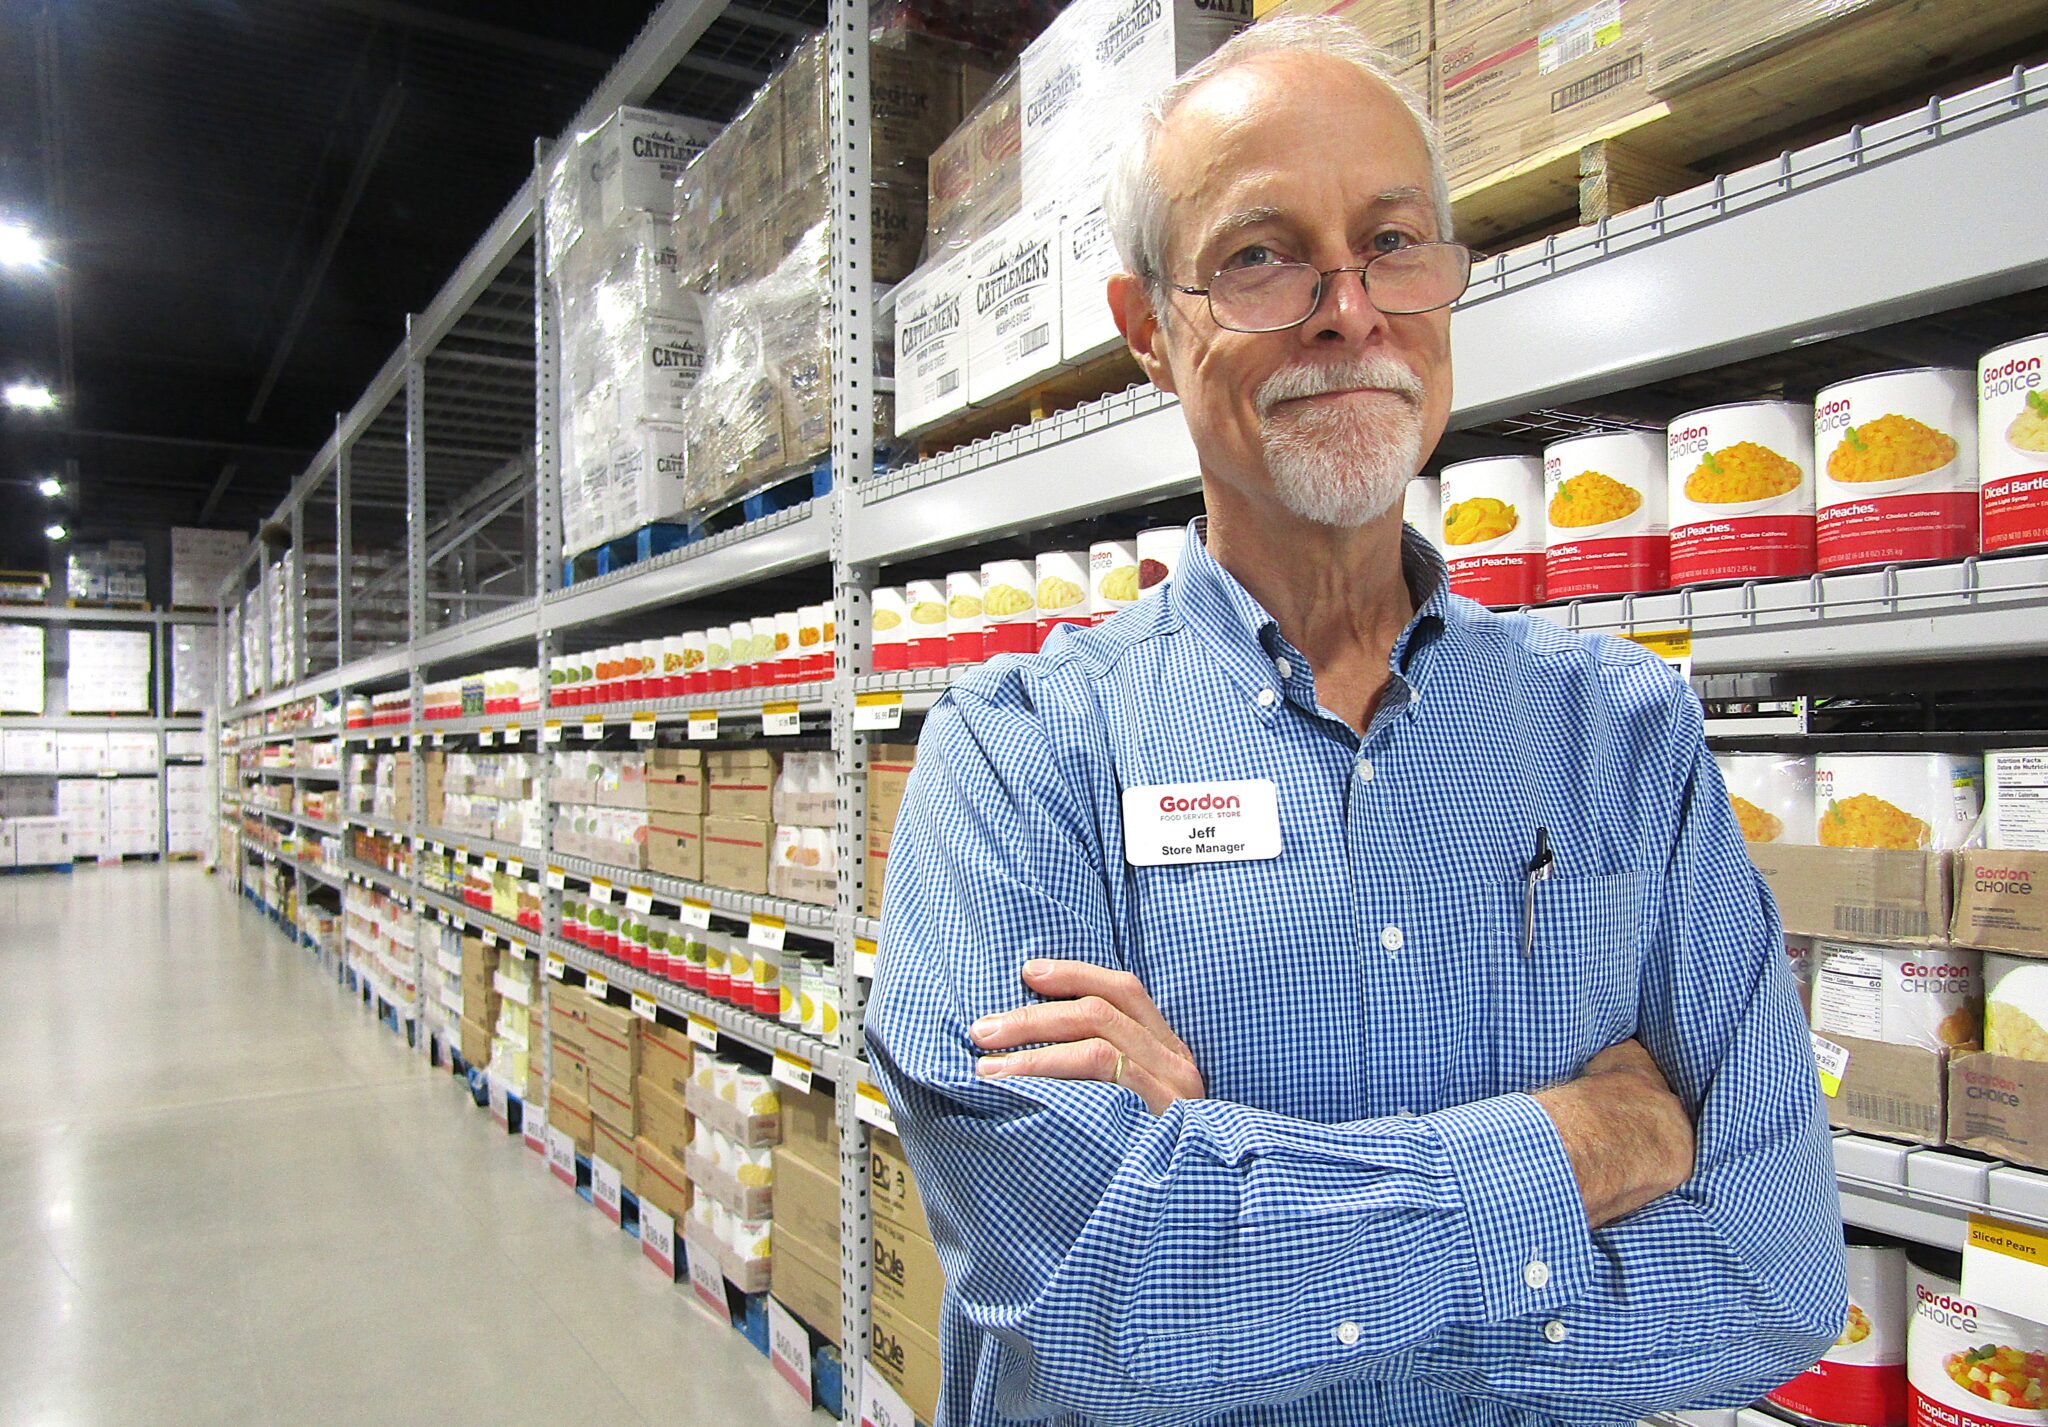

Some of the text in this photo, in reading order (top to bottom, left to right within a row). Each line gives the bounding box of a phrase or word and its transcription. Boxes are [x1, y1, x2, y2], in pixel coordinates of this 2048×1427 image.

[652, 346, 705, 368] CATTLE
[1984, 357, 2042, 384] Gordon
[1669, 426, 1709, 447] Gordon
[1984, 475, 2048, 500] Diced Bartle
[1829, 503, 1875, 519] Peaches
[1687, 523, 1731, 537] Peaches
[1456, 556, 1523, 571] Sliced Peaches
[1160, 793, 1240, 813] Gordon
[1183, 812, 1213, 820] SERVICE
[1188, 827, 1216, 839] Jeff
[1161, 842, 1246, 856] Store Manager
[1975, 866, 2029, 881] Gordon
[1900, 961, 1969, 978] Gordon
[1868, 980, 1882, 989] 60
[1972, 1230, 2038, 1255] Sliced Pears
[874, 1237, 905, 1279] Dole
[1916, 1283, 1977, 1318] Gordon
[873, 1322, 905, 1366] Dole
[1917, 1395, 1959, 1426] Tropical
